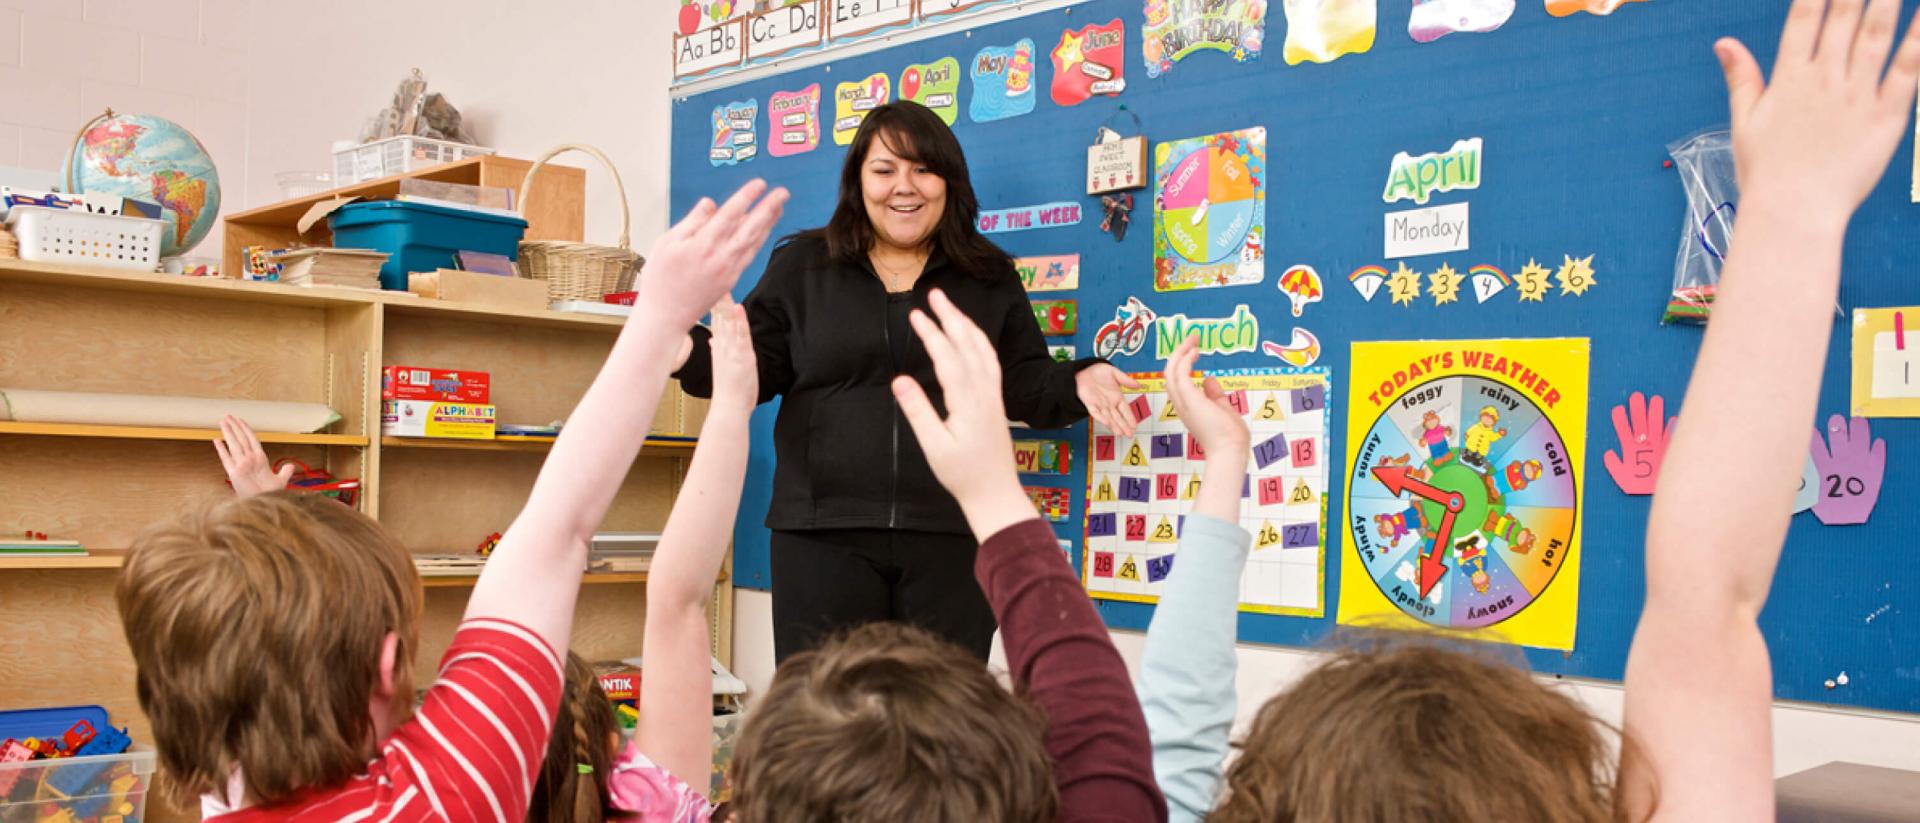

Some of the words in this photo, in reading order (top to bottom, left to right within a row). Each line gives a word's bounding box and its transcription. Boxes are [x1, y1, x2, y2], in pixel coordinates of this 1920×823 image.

[752, 16, 776, 43] Cc
[789, 1, 817, 34] Dd
[679, 37, 704, 63] Aa
[710, 27, 736, 55] Bb
[1084, 30, 1120, 51] June
[924, 64, 950, 87] April
[977, 54, 1007, 76] May
[773, 95, 811, 112] February
[1168, 156, 1201, 197] Summer
[1222, 159, 1241, 182] Fall
[1388, 148, 1477, 198] April
[980, 214, 999, 231] OF
[1006, 209, 1032, 229] THE
[1039, 204, 1080, 225] WEEK
[1215, 212, 1245, 248] Winter
[1392, 211, 1465, 246] Monday
[1170, 221, 1198, 255] Spring
[1398, 277, 1409, 295] 2
[1437, 273, 1450, 295] 3
[1481, 277, 1493, 296] 4
[1524, 272, 1538, 294] 5
[1567, 263, 1585, 287] 6
[1368, 351, 1454, 408] TODAY'S
[1462, 350, 1561, 409] WEATHER
[434, 405, 495, 417] ALPHABET
[1263, 399, 1275, 419] 5
[1301, 387, 1315, 411] 6
[1401, 384, 1444, 410] foggy
[1480, 384, 1521, 411] rainy
[1100, 438, 1111, 455] 7
[1130, 443, 1141, 466] 8
[1259, 440, 1280, 462] 12
[1295, 439, 1312, 461] 13
[1358, 433, 1382, 479] sunny
[1544, 441, 1567, 477] cold
[1634, 449, 1654, 478] 5
[1098, 484, 1111, 500] 14
[1158, 476, 1175, 496] 16
[1263, 482, 1279, 500] 19
[1293, 485, 1311, 502] 20
[1826, 473, 1865, 498] 20
[1092, 516, 1107, 531] 21
[1126, 517, 1145, 538] 22
[1155, 523, 1173, 539] 23
[1259, 527, 1279, 546] 26
[1287, 525, 1308, 546] 27
[1355, 515, 1376, 563] windy
[1095, 556, 1112, 573] 28
[1120, 562, 1137, 579] 29
[1152, 560, 1170, 577] 30
[1541, 538, 1563, 568] hot
[1391, 585, 1436, 618] cloudy
[1467, 594, 1514, 620] snowy
